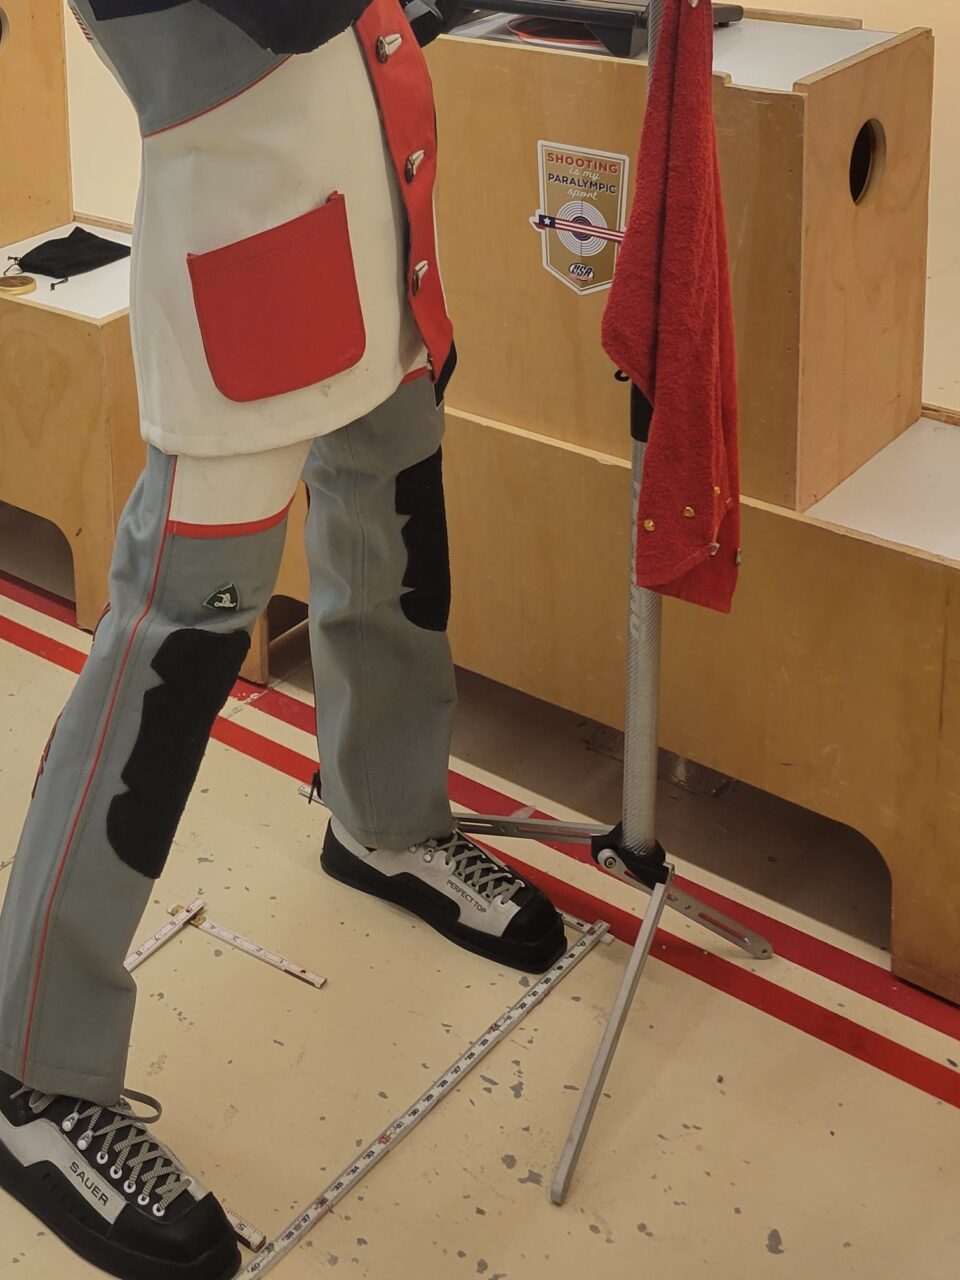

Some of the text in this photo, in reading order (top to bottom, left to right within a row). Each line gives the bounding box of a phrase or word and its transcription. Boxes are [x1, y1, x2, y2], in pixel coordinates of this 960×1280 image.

[547, 152, 619, 174] SHOOTING
[548, 173, 617, 194] PARALYMPIC
[569, 167, 601, 181] is my
[567, 188, 599, 201] sport
[571, 264, 593, 278] USA
[446, 879, 487, 914] PERFECT TOP
[70, 1162, 109, 1206] SAUER
